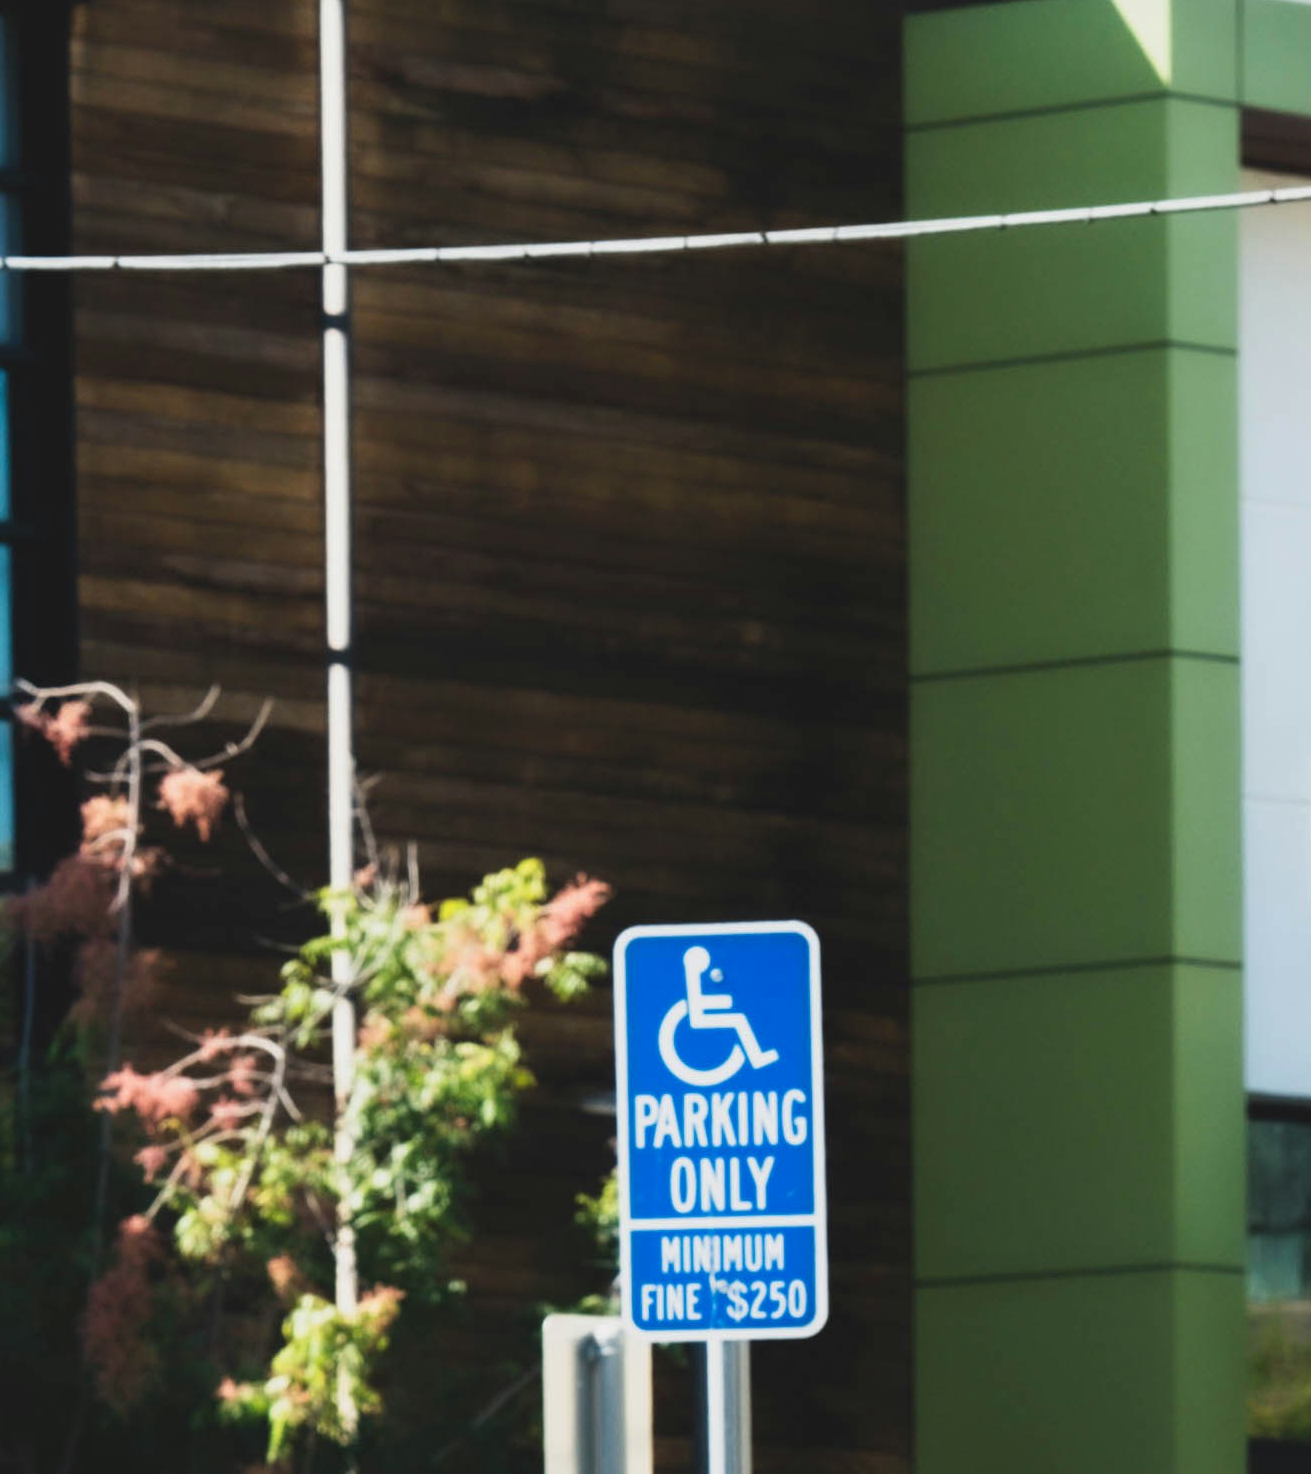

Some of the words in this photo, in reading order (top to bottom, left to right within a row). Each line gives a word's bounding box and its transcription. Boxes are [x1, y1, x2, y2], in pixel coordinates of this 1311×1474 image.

[634, 1089, 808, 1149] PARKING
[670, 1156, 775, 1214] ONLY
[661, 1233, 785, 1274] MINIMUM
[641, 1283, 702, 1321] FINE
[726, 1279, 808, 1322] $250
